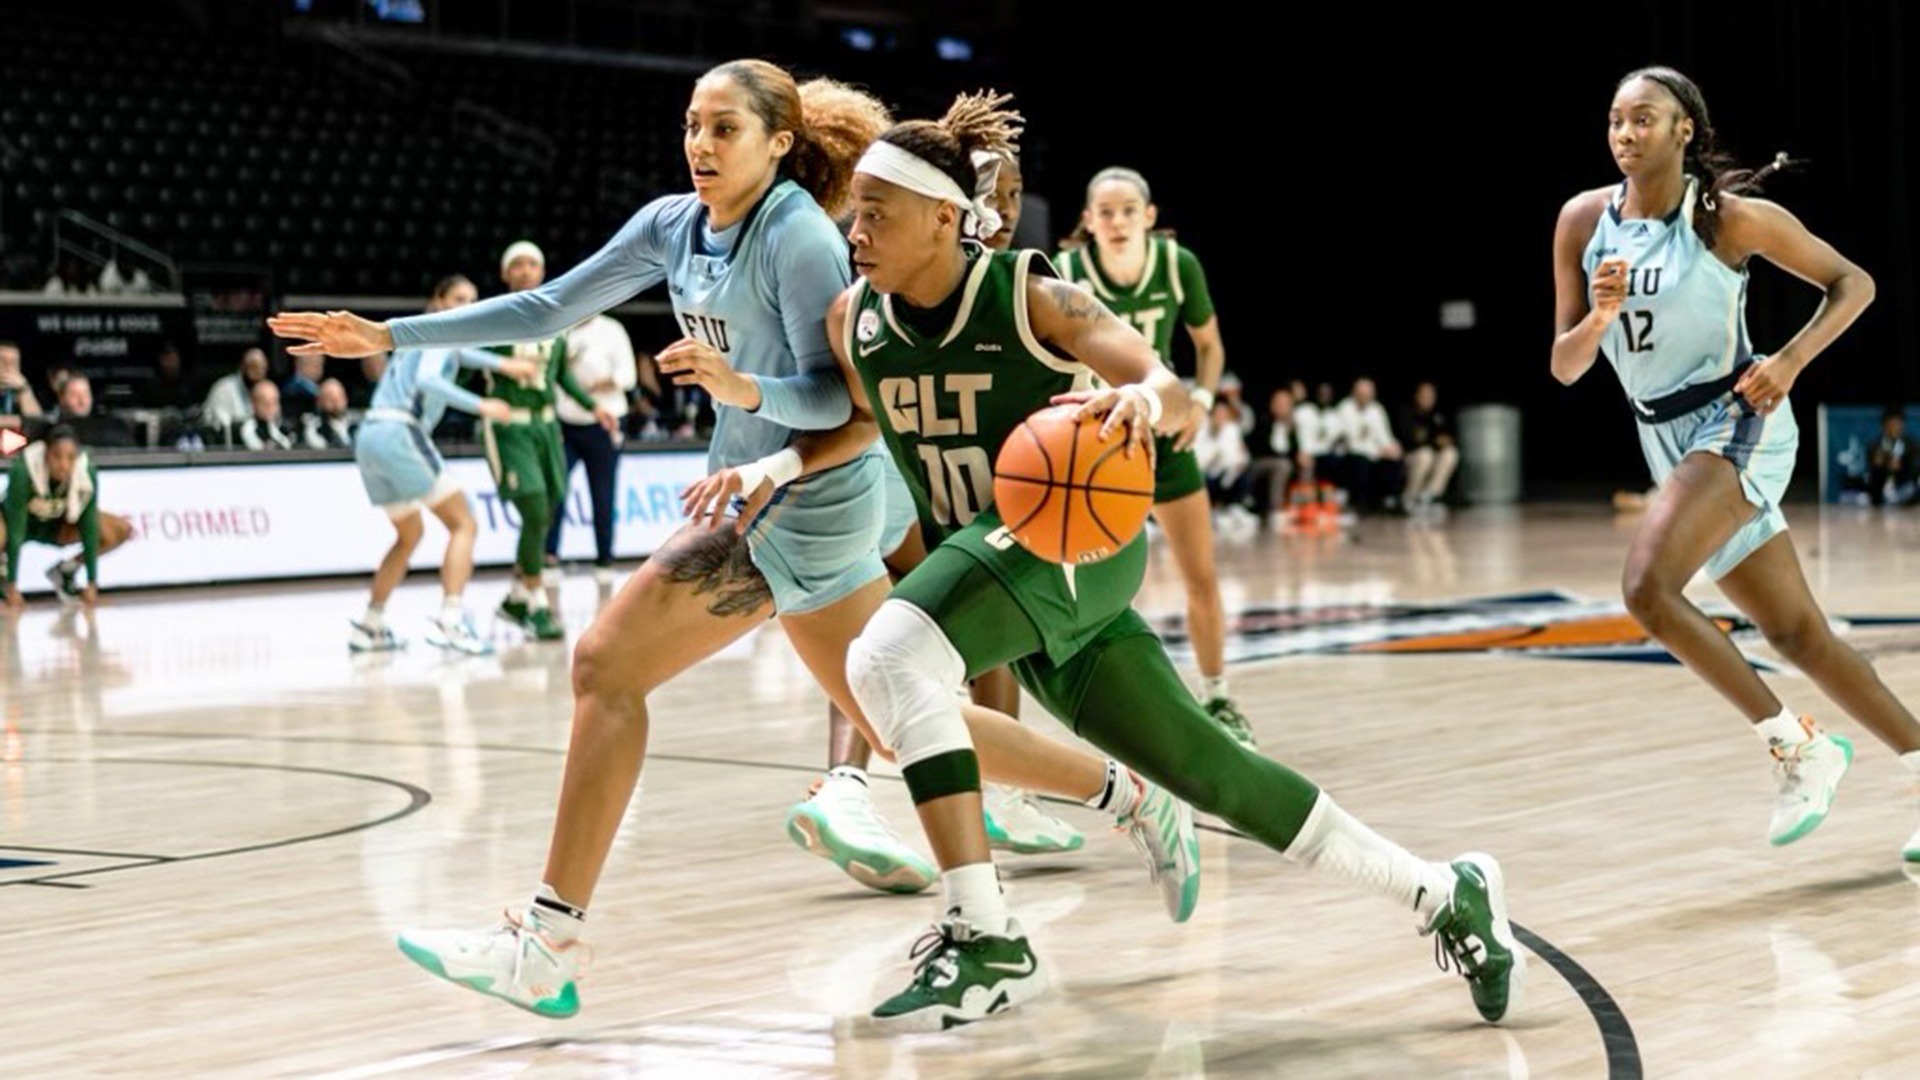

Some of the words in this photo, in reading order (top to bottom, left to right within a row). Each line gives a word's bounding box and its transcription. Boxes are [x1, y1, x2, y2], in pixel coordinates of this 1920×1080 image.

[1625, 267, 1662, 296] IU
[682, 313, 731, 353] FIU
[1619, 310, 1654, 353] 12
[916, 443, 994, 526] 10
